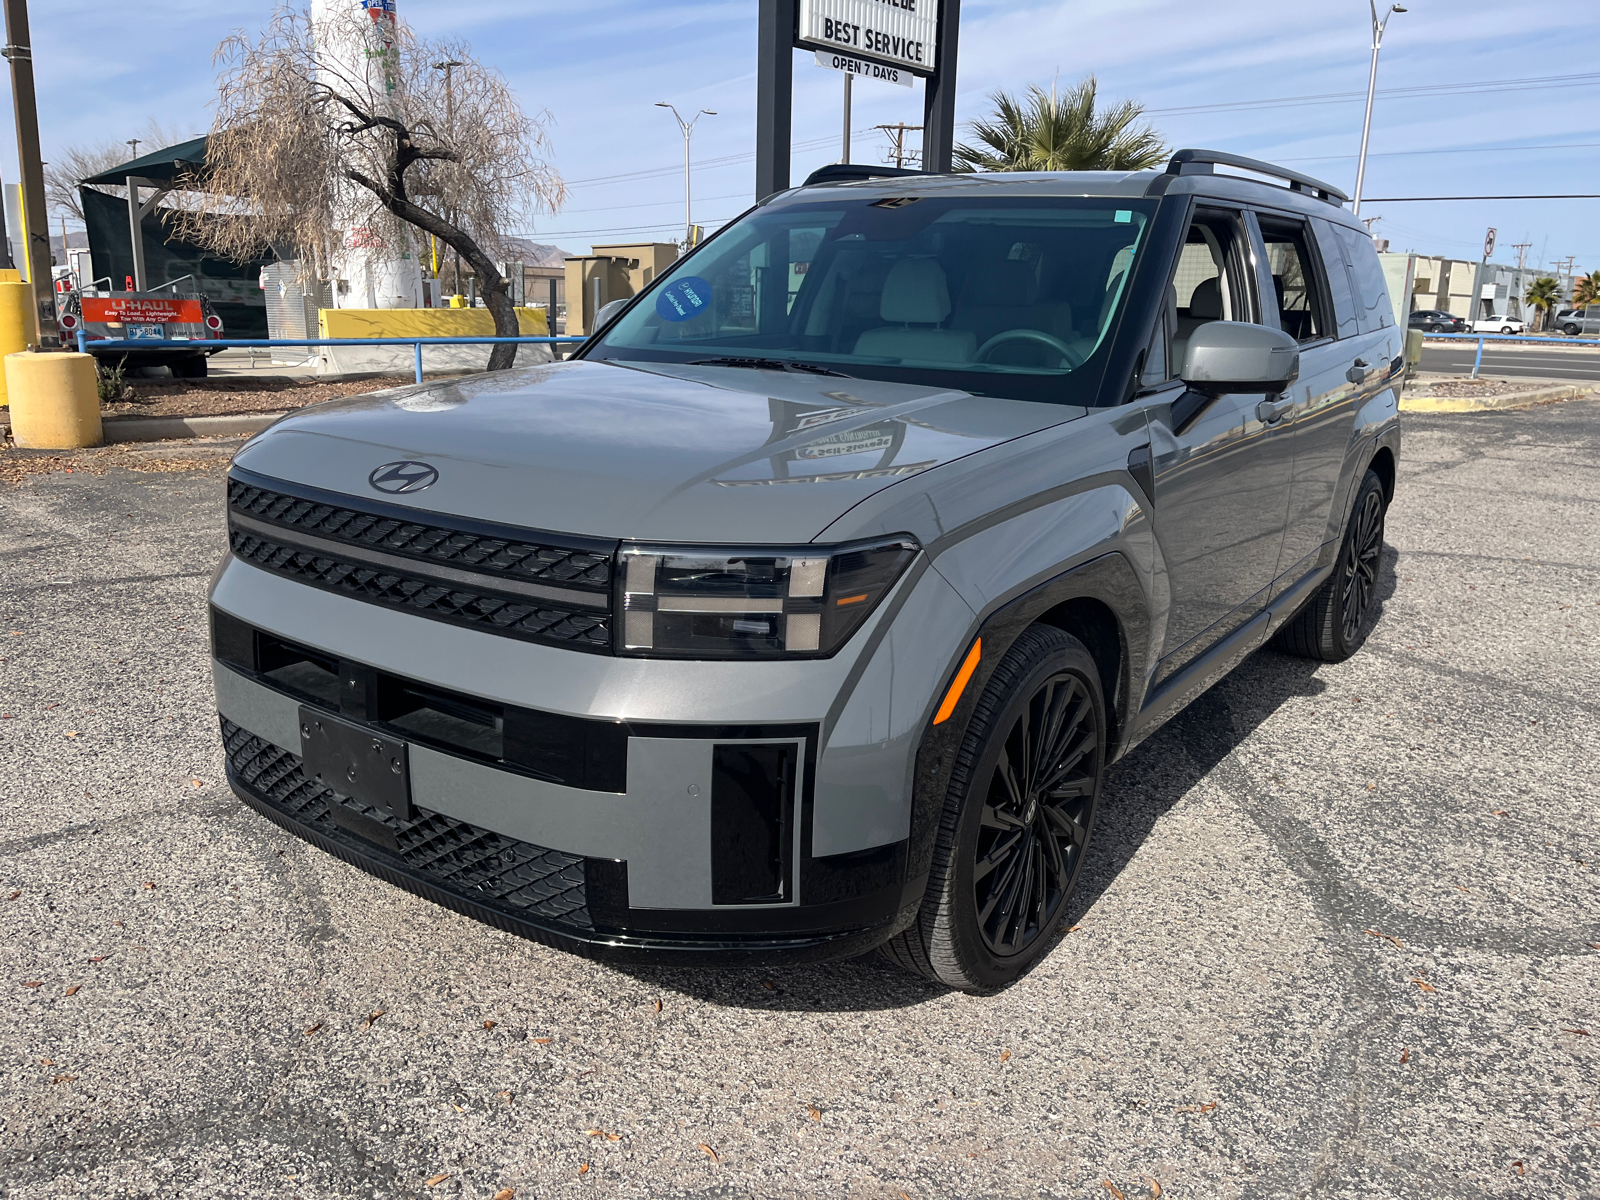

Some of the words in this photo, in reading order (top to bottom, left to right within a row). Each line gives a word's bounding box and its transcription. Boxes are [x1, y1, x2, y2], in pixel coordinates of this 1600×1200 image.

[824, 17, 860, 46] BEST
[865, 28, 923, 62] SERVICE
[832, 56, 861, 74] OPEN
[864, 63, 871, 76] 7
[873, 65, 899, 82] DAYS
[111, 300, 173, 311] U-HAUL
